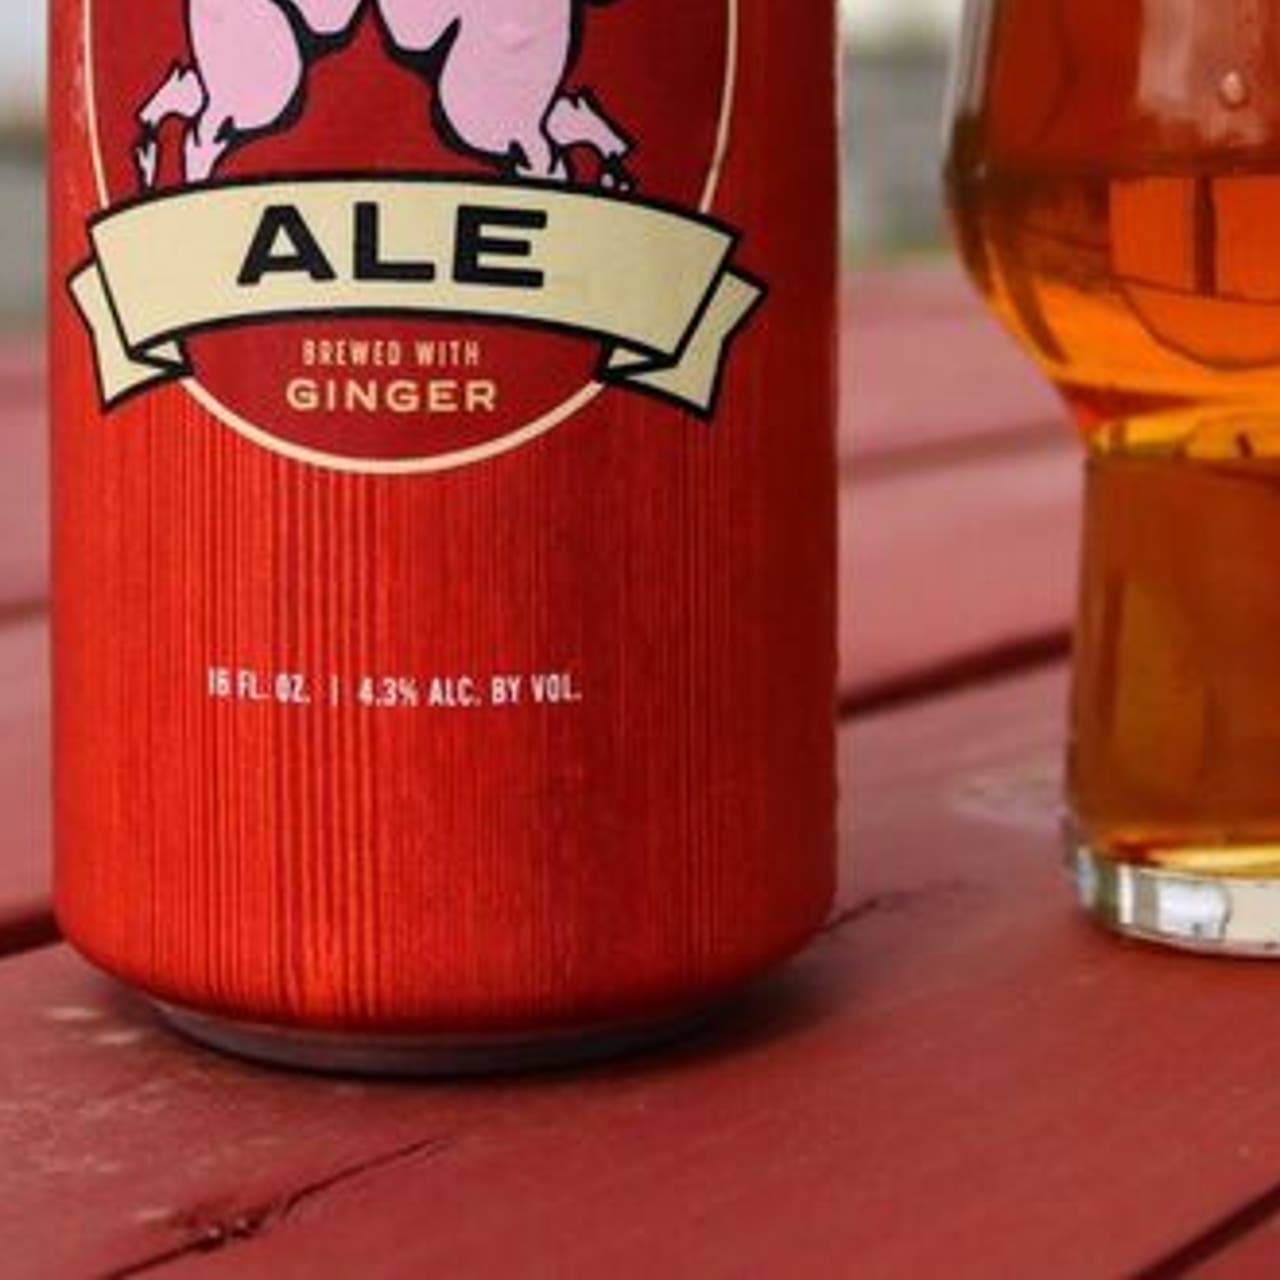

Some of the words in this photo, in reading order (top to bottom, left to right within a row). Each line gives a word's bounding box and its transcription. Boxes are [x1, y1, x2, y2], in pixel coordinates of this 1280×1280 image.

[236, 201, 548, 289] ALE
[301, 337, 402, 367] BREWED
[414, 337, 480, 367] WITH
[284, 377, 499, 413] GINGER
[208, 666, 231, 697] 16
[237, 669, 269, 701] FL.
[274, 672, 311, 704] OZ.
[357, 675, 418, 707] 4.3%
[427, 674, 482, 707] ALC.
[490, 674, 521, 704] BY
[529, 672, 583, 703] VOL.
